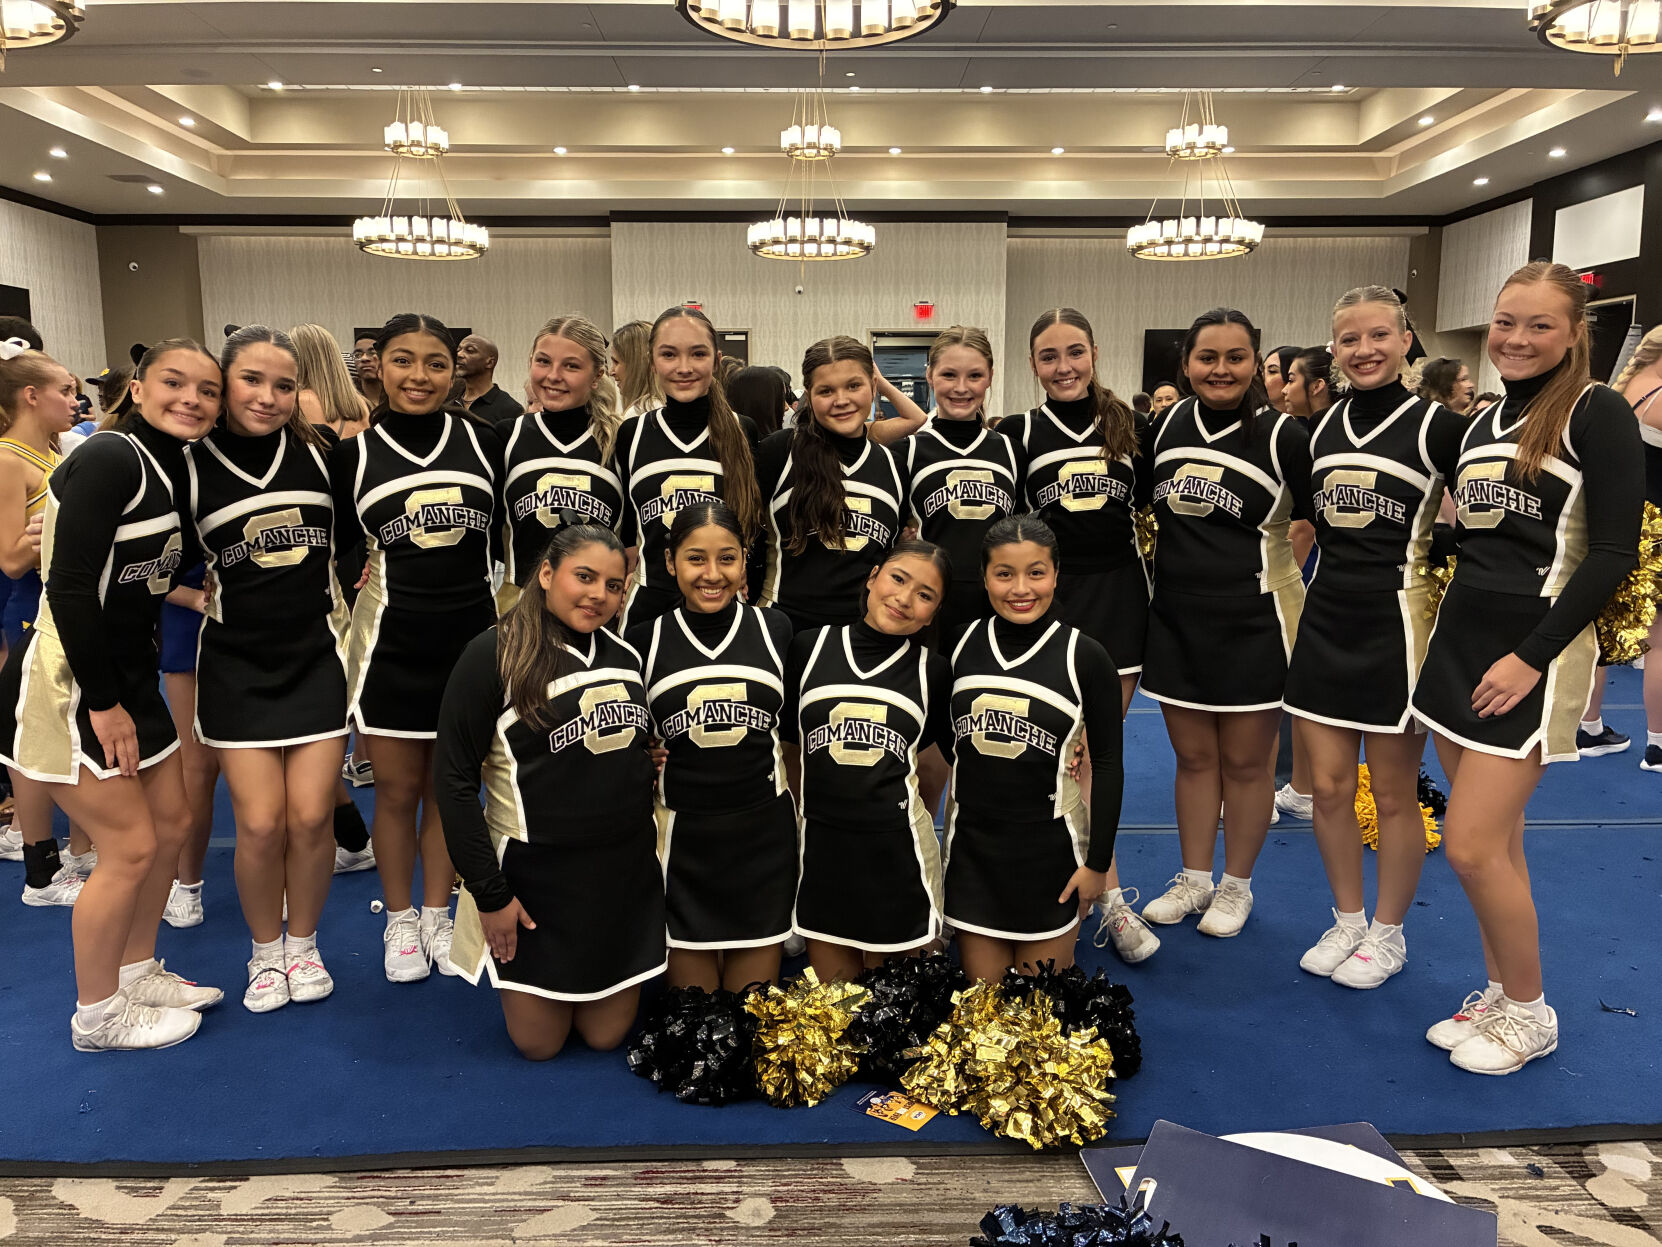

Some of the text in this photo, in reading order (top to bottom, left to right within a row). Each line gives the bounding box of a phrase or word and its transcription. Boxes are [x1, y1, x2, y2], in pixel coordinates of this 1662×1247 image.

[514, 486, 613, 526] COMANCHE
[640, 491, 727, 524] COMAN
[1037, 475, 1129, 508] COMANCHE
[1453, 480, 1543, 520] MANCHE
[380, 507, 489, 545] COMANCHE
[222, 527, 328, 567] COMANCHE
[549, 702, 650, 753] COMANCHE
[662, 702, 771, 740] COMANCHE
[955, 711, 1057, 756] COMANCHE
[807, 721, 908, 763] COMANCHE
